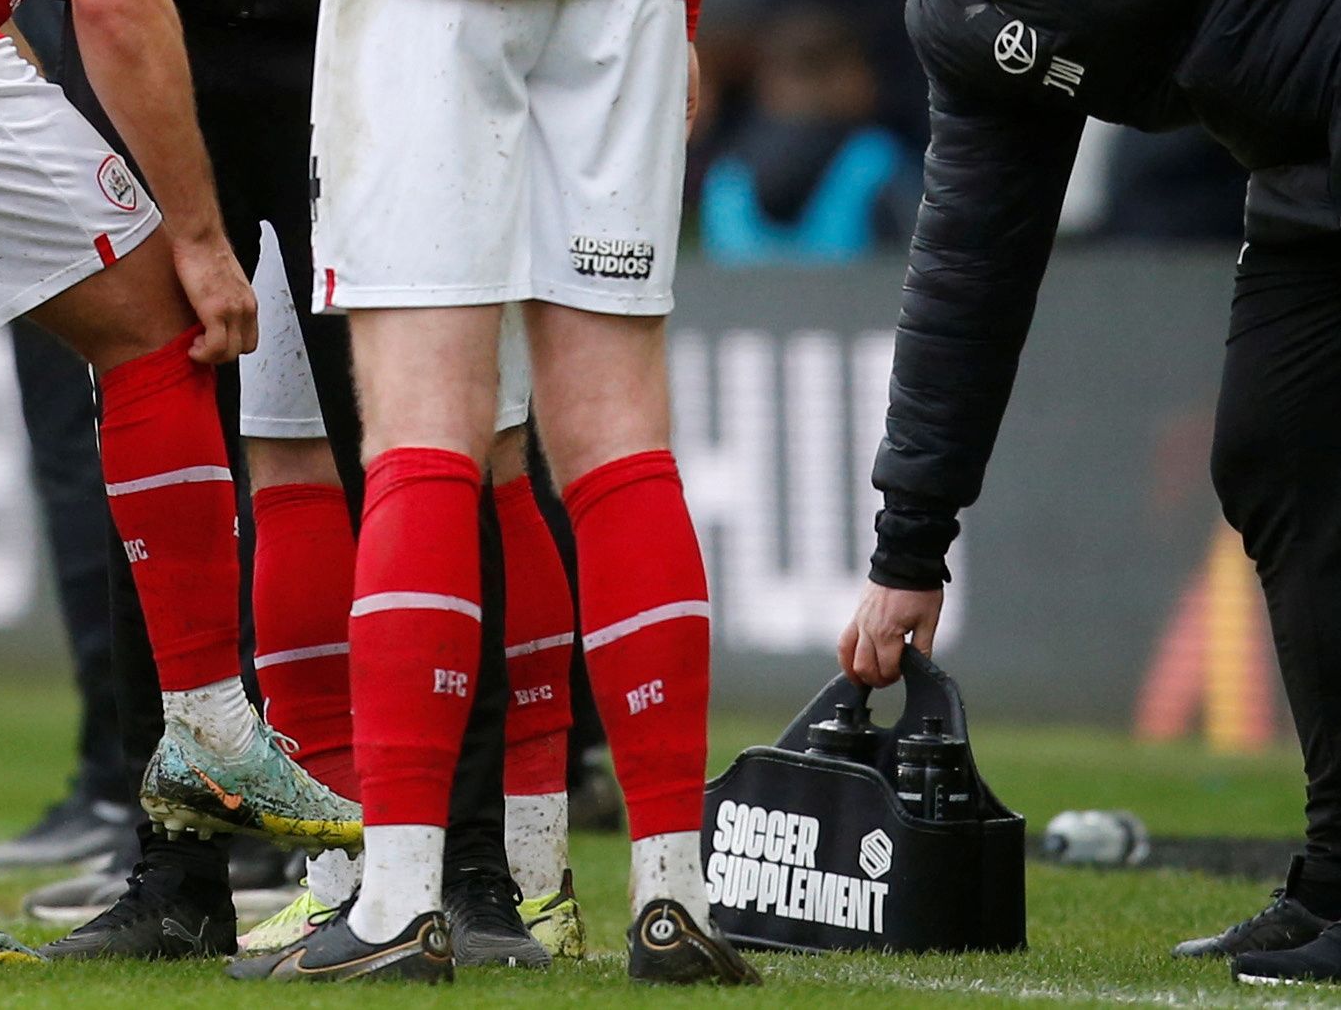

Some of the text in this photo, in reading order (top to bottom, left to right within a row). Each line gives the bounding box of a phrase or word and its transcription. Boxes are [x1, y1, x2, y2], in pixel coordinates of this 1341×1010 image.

[568, 235, 654, 260] KIDSUPER
[571, 252, 650, 278] STUDIOS
[433, 668, 468, 697] BFC
[514, 684, 553, 706] BFC
[626, 679, 664, 715] BFC
[713, 799, 820, 868] SOCCER
[705, 851, 889, 934] SUPPLEMENT
